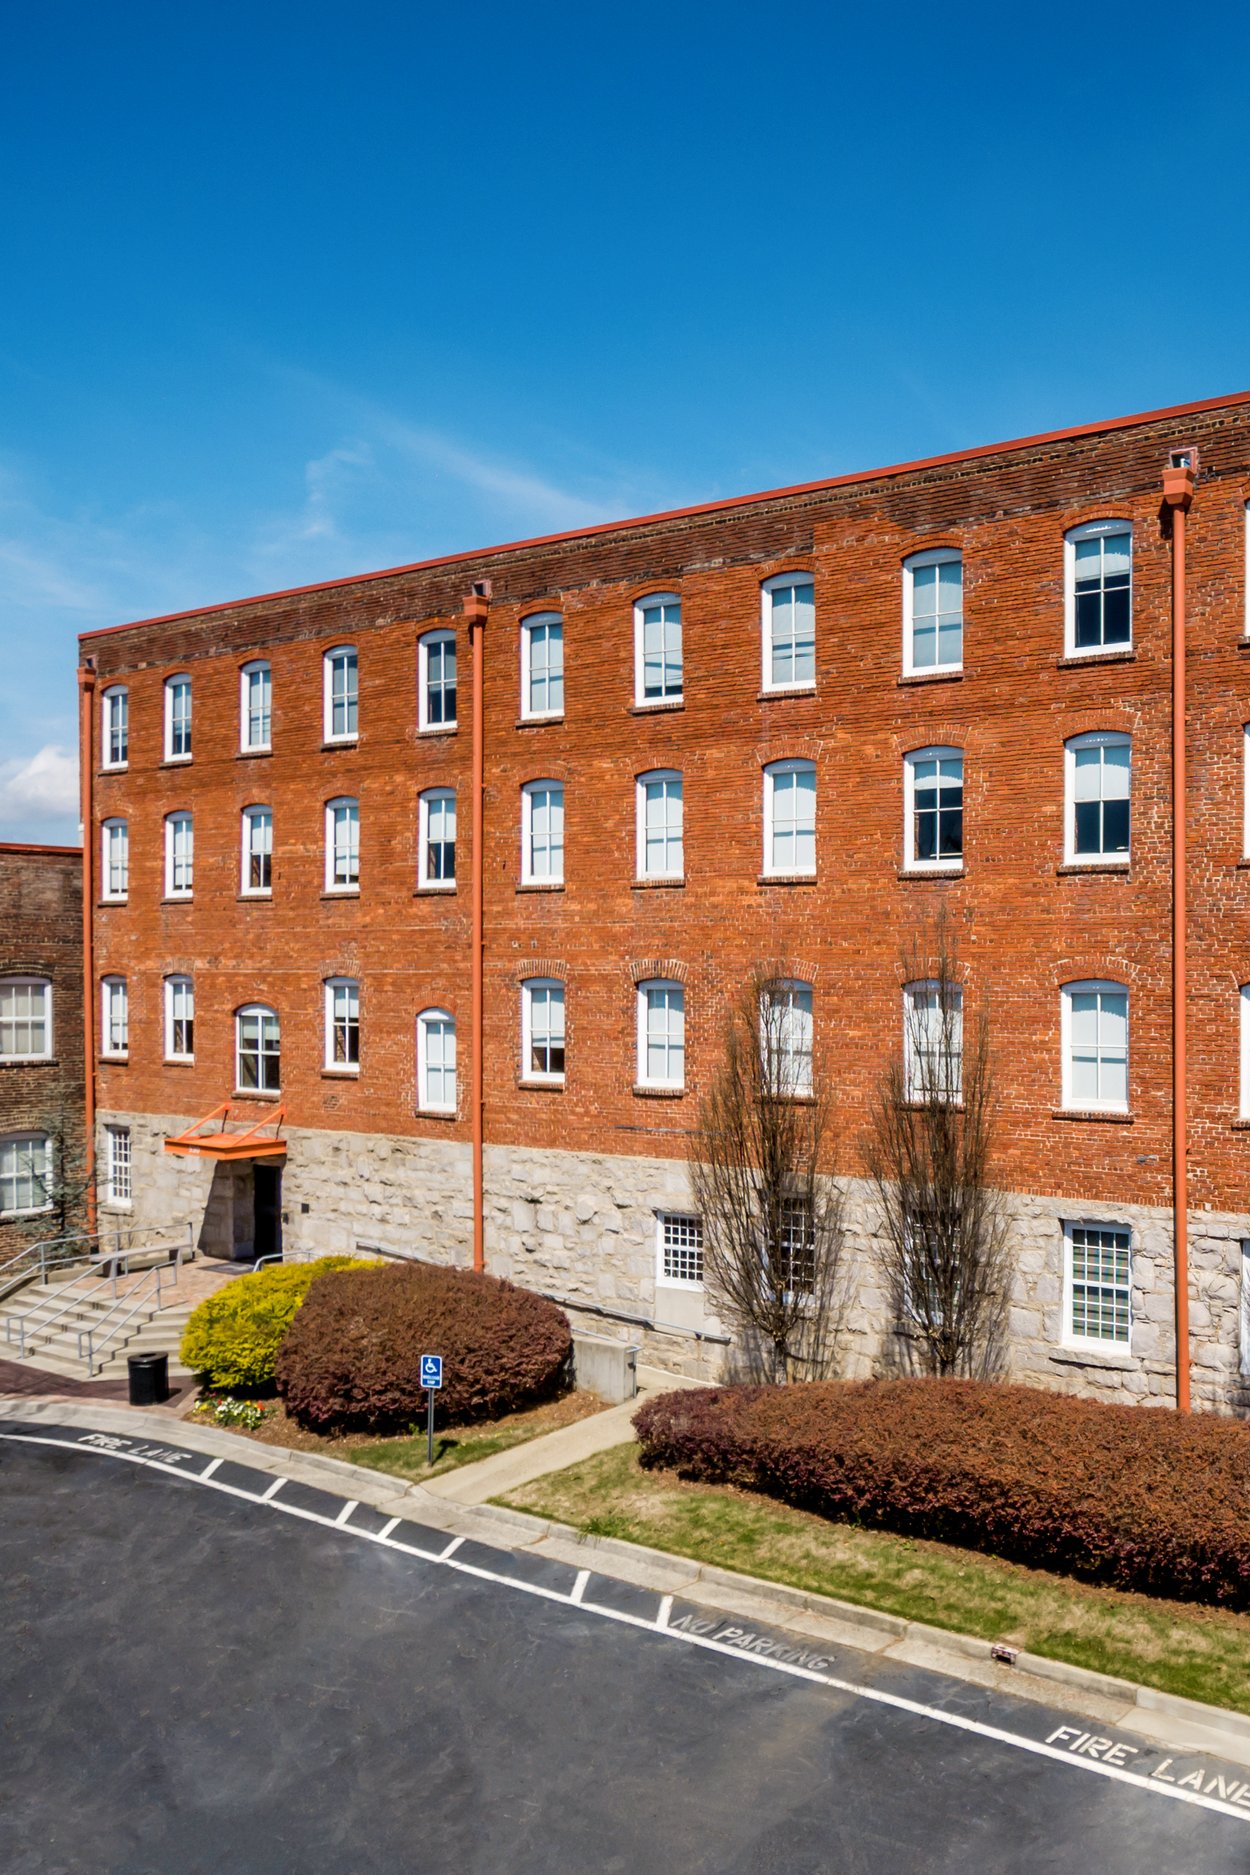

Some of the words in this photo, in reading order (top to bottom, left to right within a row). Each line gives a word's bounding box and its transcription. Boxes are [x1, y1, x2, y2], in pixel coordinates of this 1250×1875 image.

[78, 1434, 133, 1449] FIRE
[128, 1445, 192, 1463] LANE
[671, 1615, 712, 1634] NO
[712, 1626, 835, 1670] PARKING
[1045, 1725, 1139, 1766] FIRE
